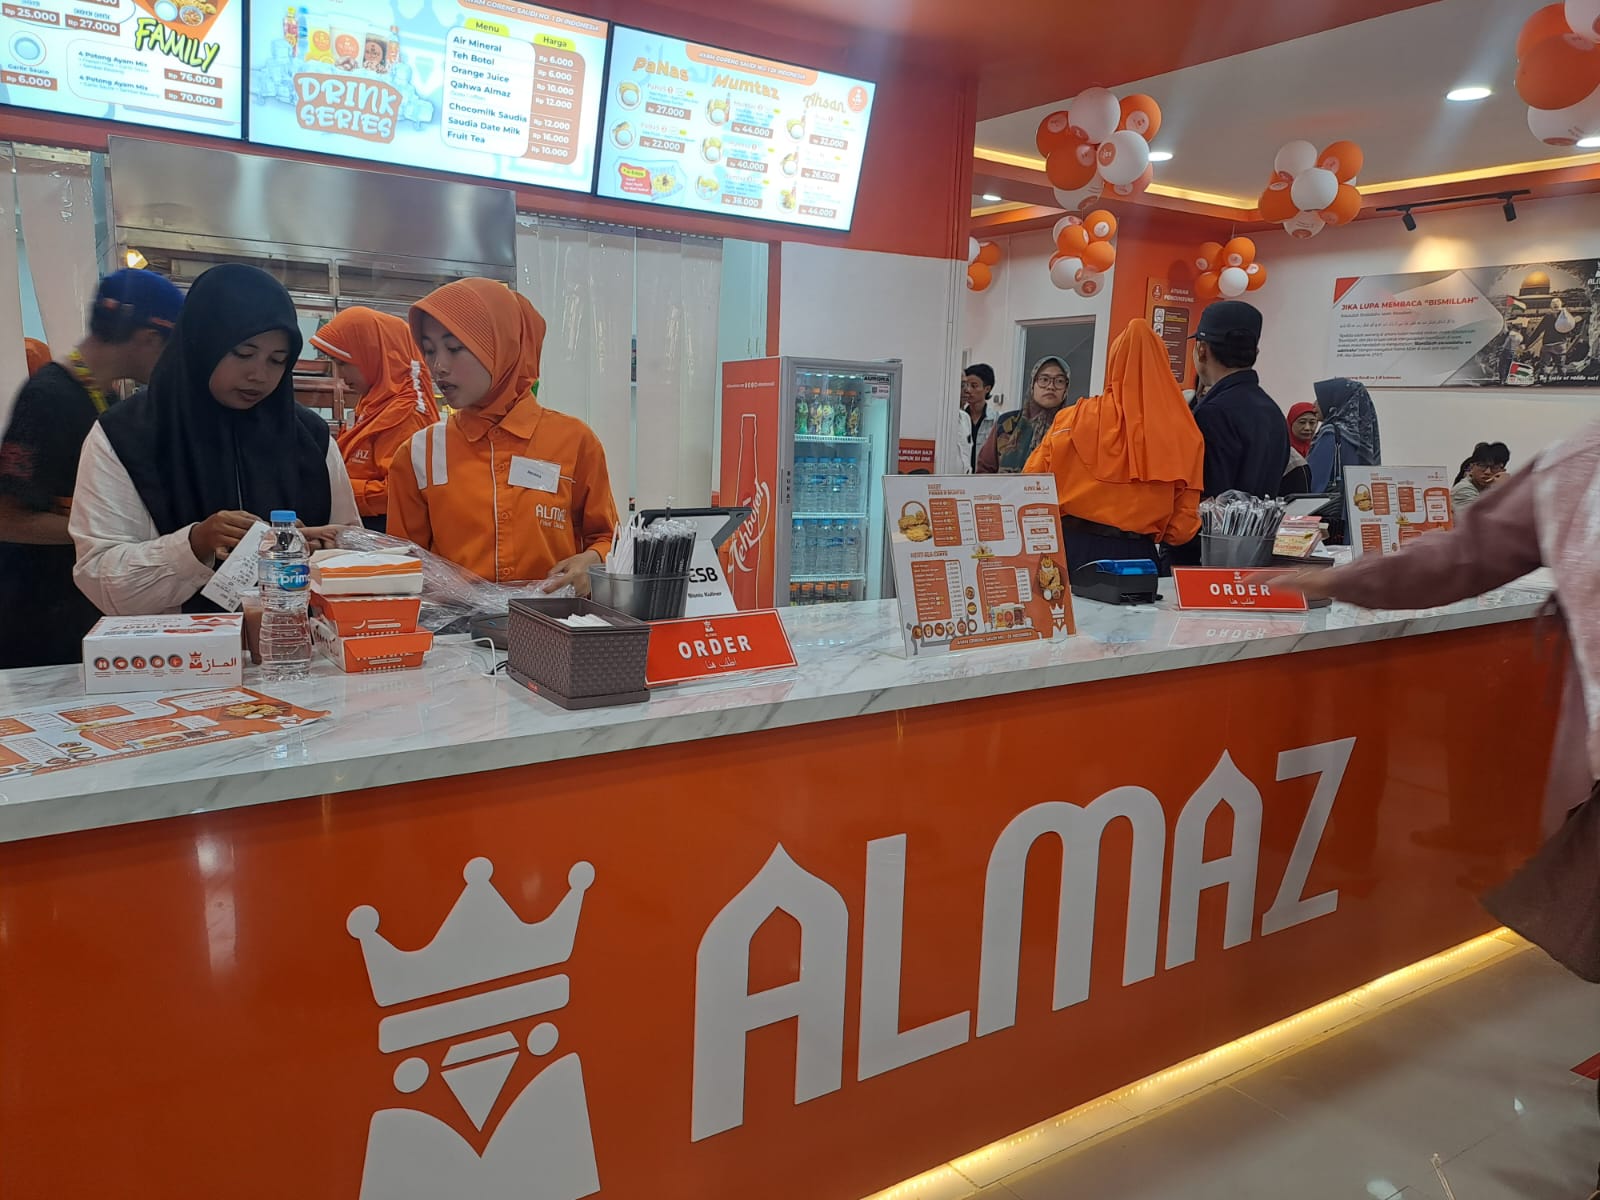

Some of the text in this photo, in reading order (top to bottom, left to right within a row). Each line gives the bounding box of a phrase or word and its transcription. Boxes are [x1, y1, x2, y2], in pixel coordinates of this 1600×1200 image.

[17, 8, 57, 22] 25.000
[80, 19, 117, 33] 27.000
[475, 21, 500, 33] Menu
[135, 17, 220, 73] FAMILY
[453, 36, 502, 52] Air Mineral
[543, 36, 567, 48] Harga
[452, 51, 495, 65] Teh Botol
[539, 55, 574, 67] Rp 6.000
[18, 75, 51, 88] 6.000
[180, 73, 216, 86] 76.000
[451, 66, 509, 83] Orange Juice
[450, 80, 482, 93] Qahwa
[484, 86, 511, 98] Almaz
[180, 94, 216, 106] 70.000
[298, 77, 397, 116] DRINK
[546, 97, 573, 109] 12.000
[449, 103, 528, 122] Chocomilk Saudia
[300, 104, 392, 138] SERIES
[448, 117, 521, 135] Saudia Date Milk
[543, 120, 571, 131] 12.000
[447, 130, 486, 144] Fruit Tea
[1382, 300, 1422, 308] MEMBACA
[281, 571, 310, 586] prim
[688, 567, 718, 583] ESB
[1210, 583, 1271, 596] ORDER
[678, 635, 752, 659] ORDER
[691, 736, 1357, 1143] ALMAZ
